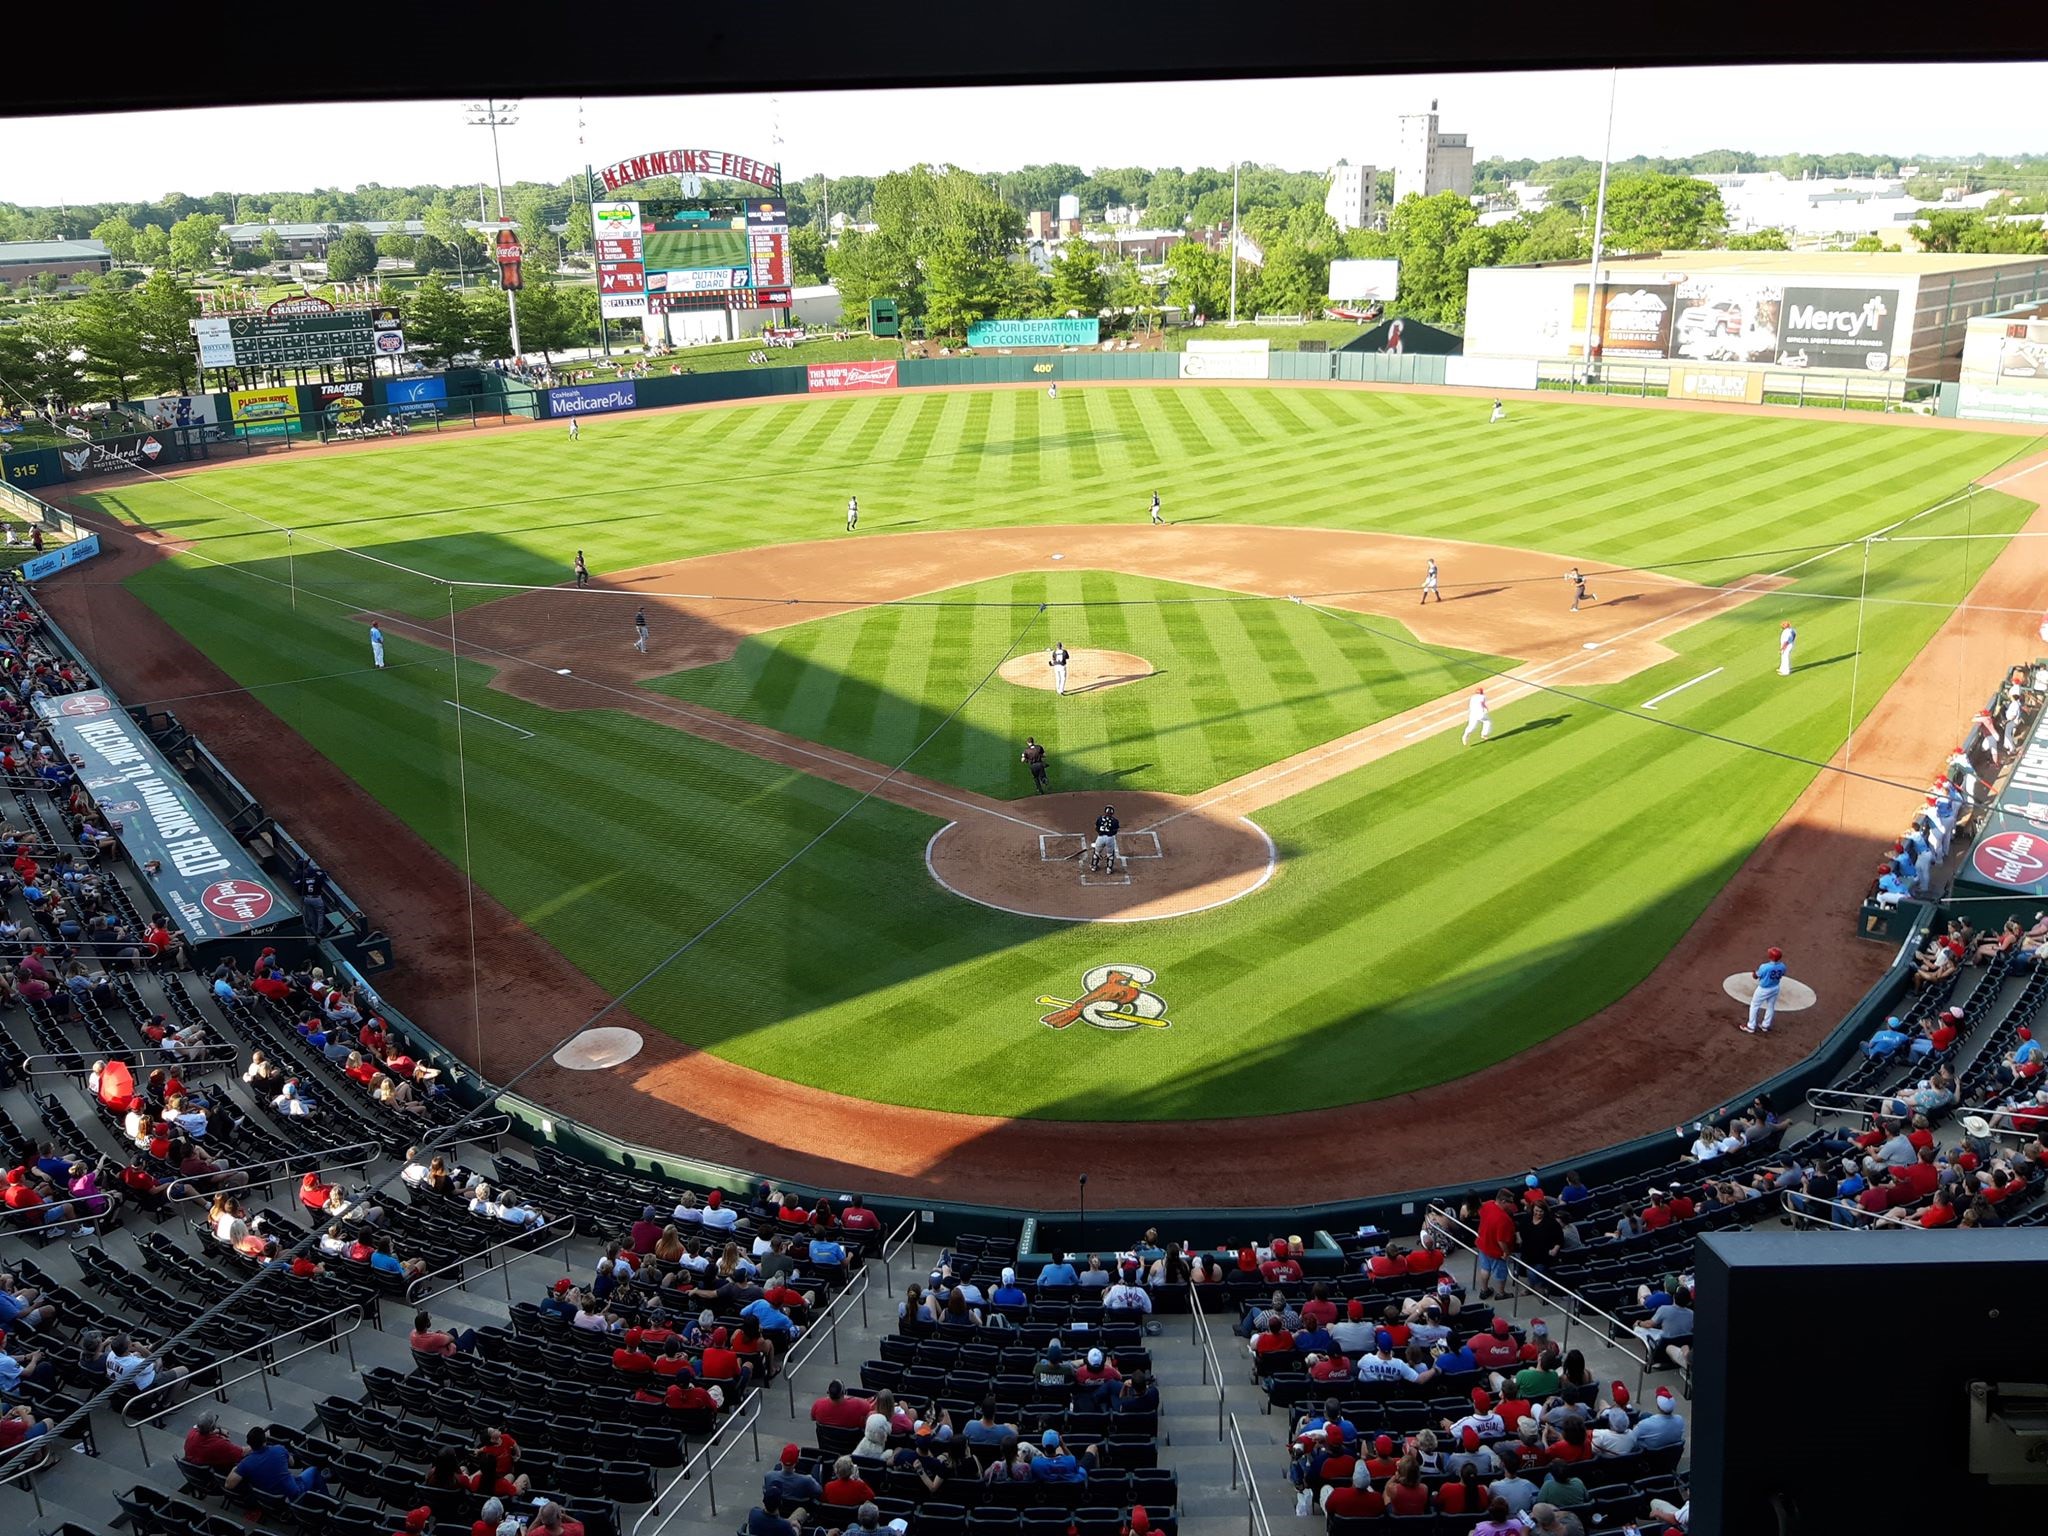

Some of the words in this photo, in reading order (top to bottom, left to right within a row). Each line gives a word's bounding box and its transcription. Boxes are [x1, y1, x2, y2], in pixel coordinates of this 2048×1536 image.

[601, 150, 710, 192] HAMMONS
[721, 152, 776, 188] FIELD
[692, 270, 728, 280] CUTTING
[695, 279, 724, 289] BOARD
[734, 275, 748, 286] 27
[271, 304, 331, 315] CHAMPIONS
[611, 298, 645, 307] PURINA
[968, 322, 1020, 334] MISSOURI
[1023, 321, 1095, 332] DEPARTMENT
[1788, 304, 1866, 337] Mercy
[982, 335, 997, 345] OF
[1000, 333, 1081, 345] CONSERVATION
[1608, 332, 1657, 342] INSURANCE
[810, 370, 826, 379] THIS
[826, 368, 848, 378] BUD'S
[321, 382, 363, 395] TRACKER
[810, 378, 824, 387] FOR
[551, 390, 580, 399] CoxHealth
[552, 391, 634, 413] MedicarePlus
[93, 439, 141, 463] Federal
[13, 464, 39, 478] 315'
[73, 718, 145, 766] WELCOME
[119, 762, 155, 778] TO
[133, 777, 200, 839] HAMMONS
[166, 836, 232, 877] FIELD
[1985, 834, 2043, 869] Cutter
[1995, 859, 2022, 882] Price
[215, 881, 237, 896] Price
[212, 892, 265, 919] Cutter
